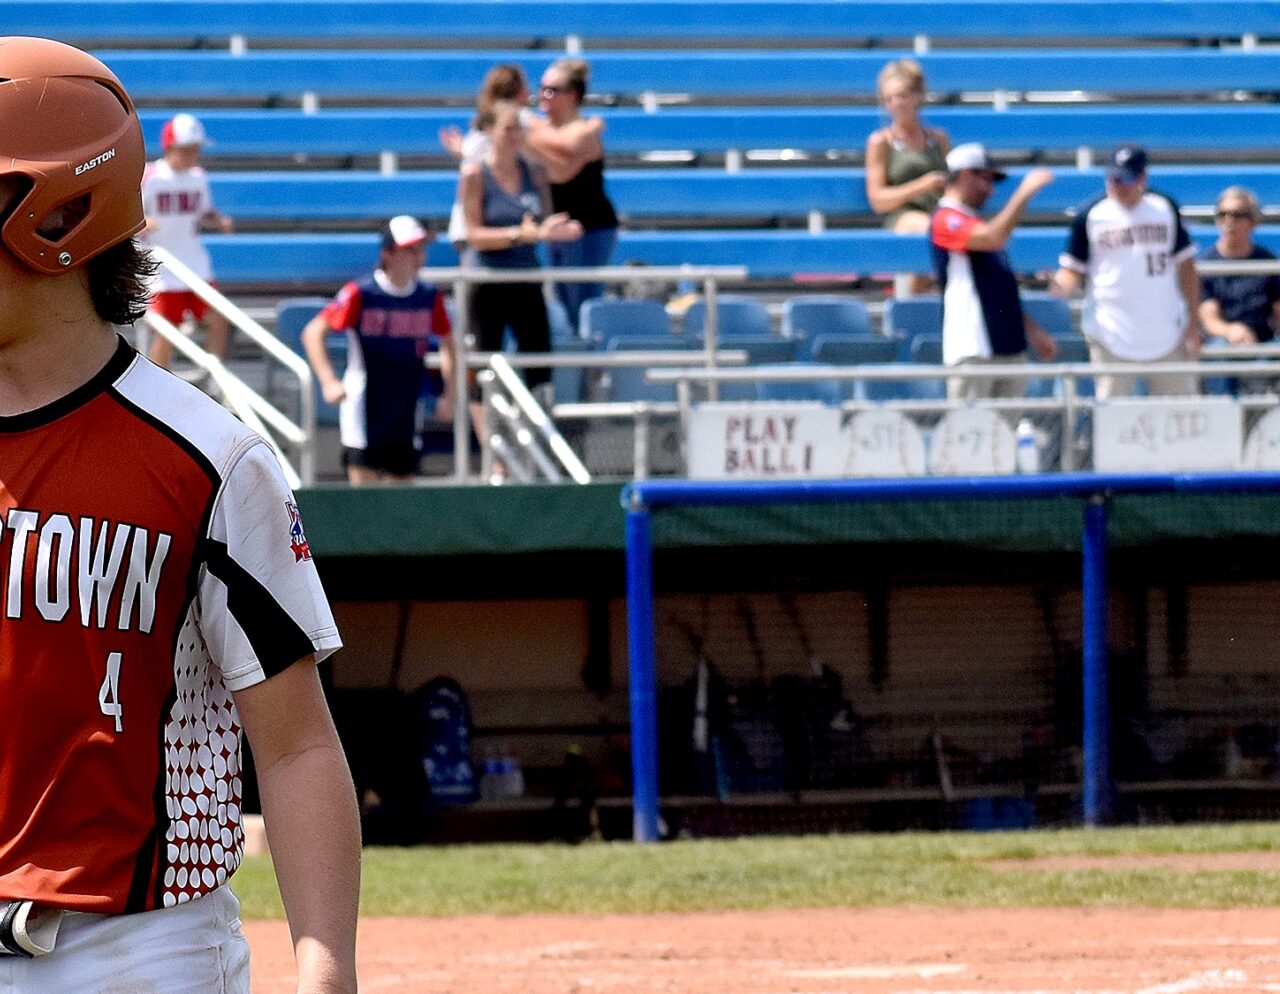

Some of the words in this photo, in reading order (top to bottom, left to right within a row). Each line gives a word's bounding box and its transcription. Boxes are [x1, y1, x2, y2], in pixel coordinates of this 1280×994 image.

[75, 148, 116, 176] EASTON
[725, 415, 796, 443] PLAY
[98, 651, 123, 733] 4
